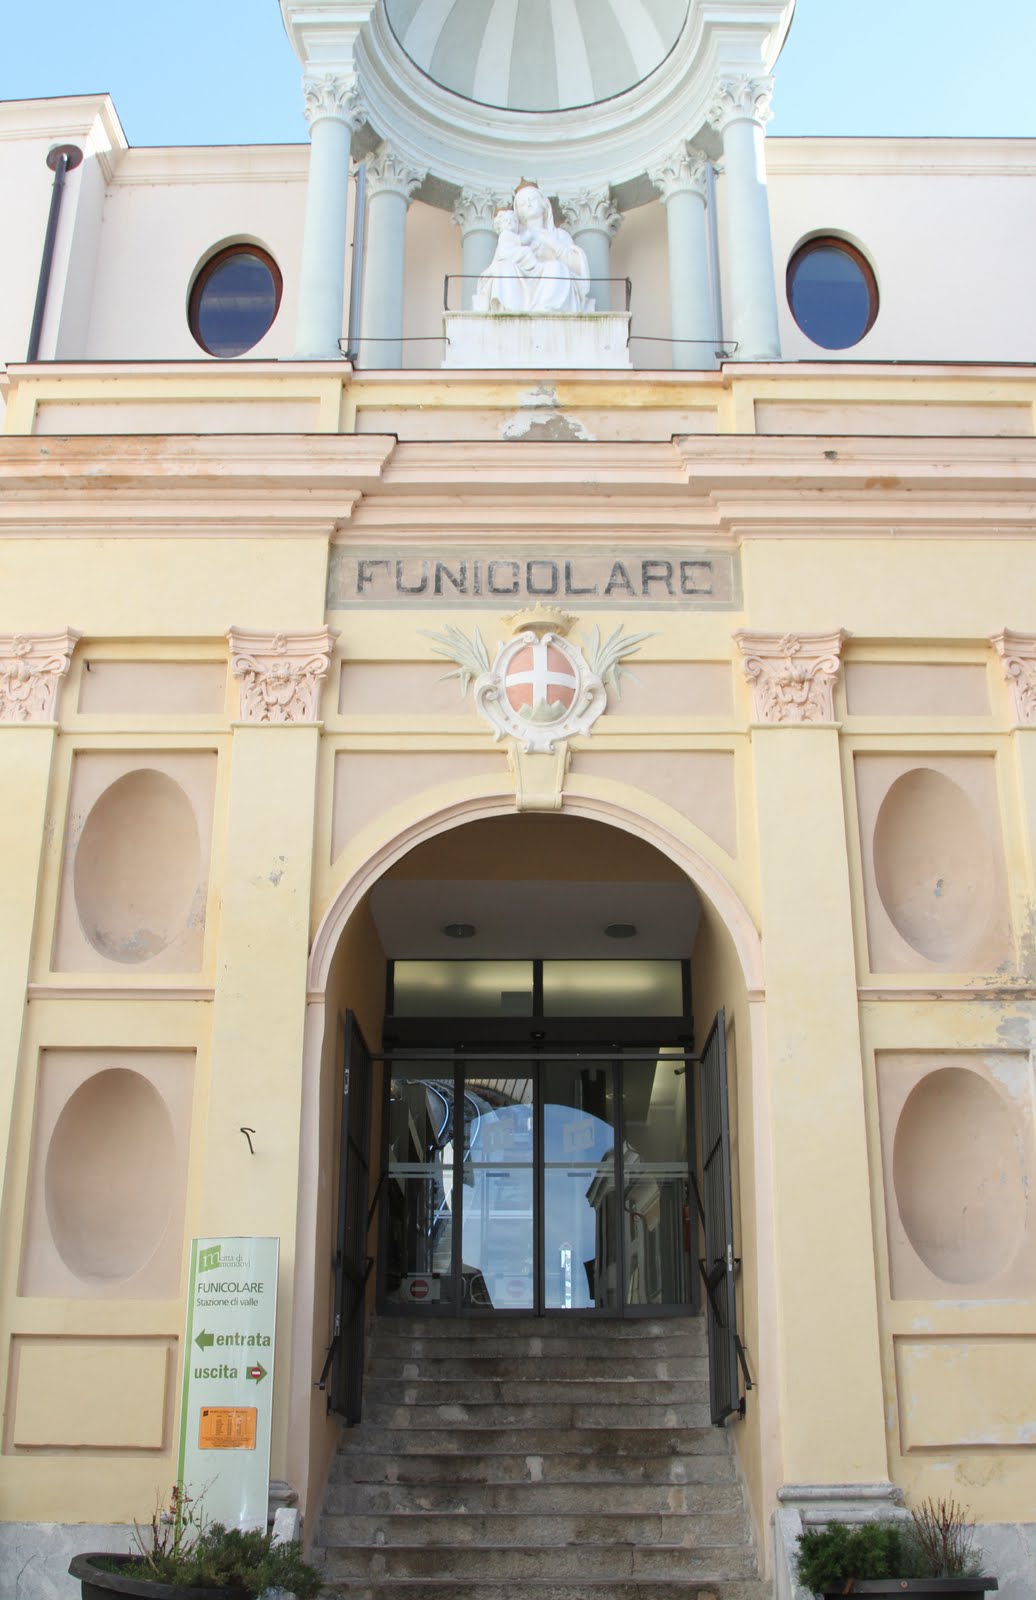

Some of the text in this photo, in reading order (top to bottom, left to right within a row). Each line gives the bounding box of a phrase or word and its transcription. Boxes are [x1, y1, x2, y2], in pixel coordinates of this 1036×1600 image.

[356, 560, 714, 595] FUNICOLARE
[197, 1282, 264, 1293] FUNICOLARE
[196, 1297, 259, 1307] Stazione di valle
[216, 1332, 271, 1347] entrata
[194, 1364, 239, 1379] uscita
